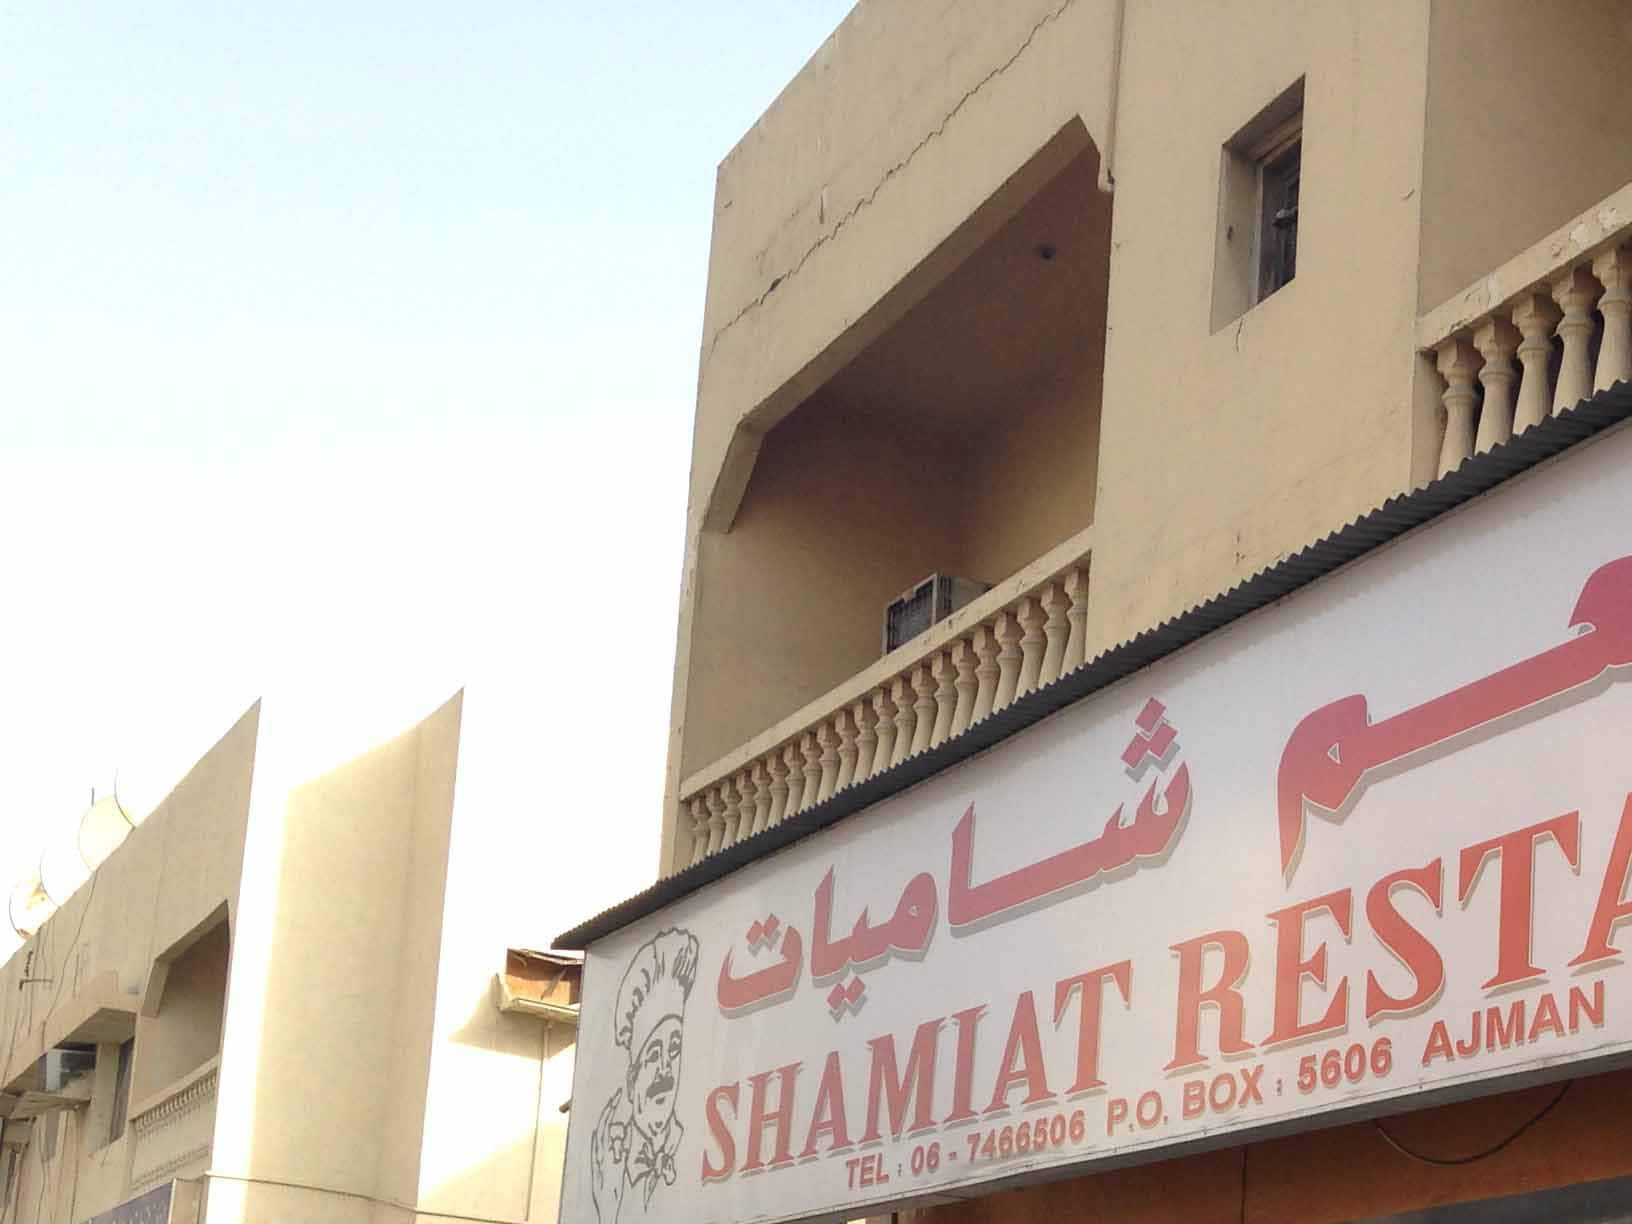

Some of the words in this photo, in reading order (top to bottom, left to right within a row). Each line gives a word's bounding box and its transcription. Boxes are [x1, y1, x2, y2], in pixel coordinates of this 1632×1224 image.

[717, 696, 1193, 1014] شاميات
[701, 959, 1133, 1182] SHAMIAT
[910, 1139, 941, 1173] 06
[966, 1110, 1087, 1165] 7466506
[1107, 1090, 1168, 1135] P.O.
[1297, 1037, 1394, 1092] 5606
[1421, 980, 1606, 1066] AJMAN
